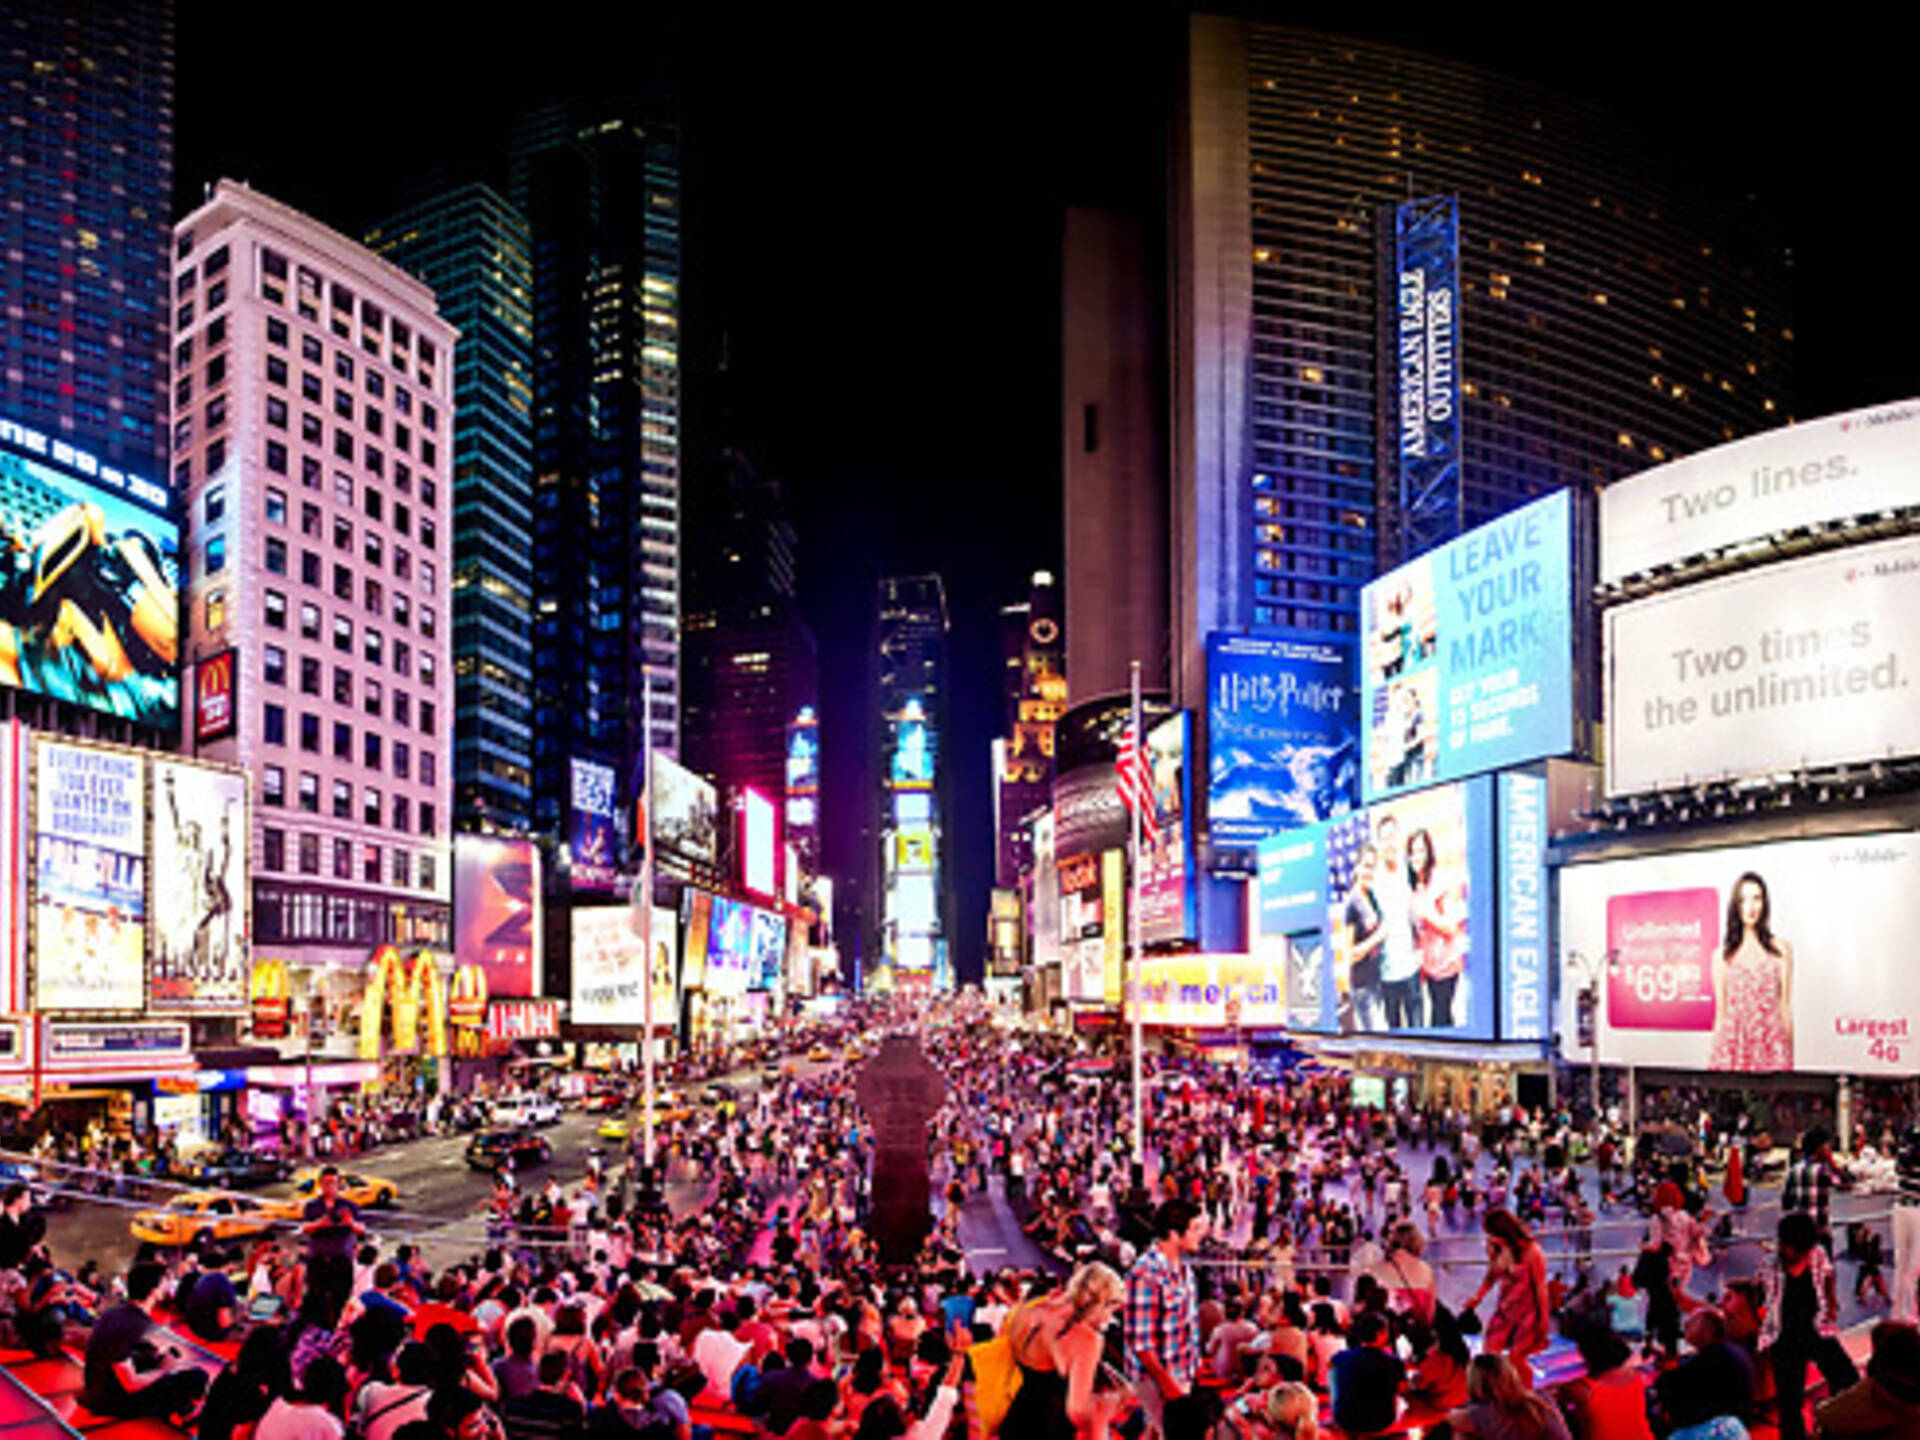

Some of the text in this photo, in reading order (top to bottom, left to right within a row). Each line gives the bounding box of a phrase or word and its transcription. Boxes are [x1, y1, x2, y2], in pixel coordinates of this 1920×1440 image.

[1427, 288, 1452, 423] OUTFITTERS
[1400, 336, 1425, 458] AMERICAN
[1660, 454, 1858, 523] Two lines.
[1450, 510, 1541, 581] LEAVE
[1458, 560, 1541, 623] YOUR
[1450, 609, 1541, 676] MARK
[1672, 644, 1747, 683] Two
[1277, 670, 1344, 718] Potter
[1643, 652, 1909, 731] the unlimited.
[1834, 1016, 1910, 1039] Largest
